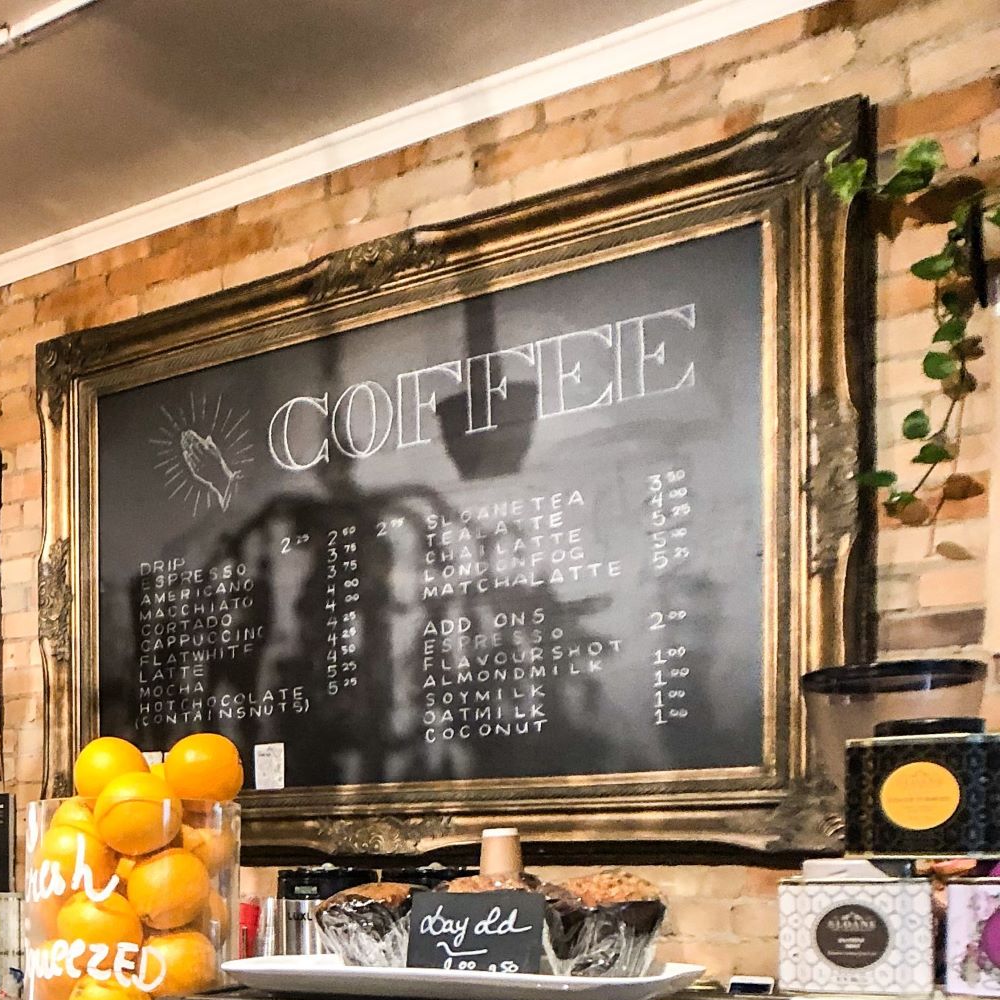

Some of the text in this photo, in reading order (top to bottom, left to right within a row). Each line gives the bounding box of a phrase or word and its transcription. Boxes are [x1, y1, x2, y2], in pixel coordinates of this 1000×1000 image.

[269, 303, 696, 471] COFFEE
[140, 557, 185, 576] DRIP
[141, 563, 247, 591] ESPRESSO
[141, 578, 255, 605] AMERICANO
[139, 597, 254, 621] MACCHIATO
[141, 614, 233, 636] CORTADO
[423, 617, 472, 637] ADD
[494, 607, 546, 630] ONS
[424, 627, 564, 656] ESPRESSO
[139, 664, 204, 683] LATTE
[139, 681, 204, 698] MOCHA
[424, 719, 549, 744] COCONUT
